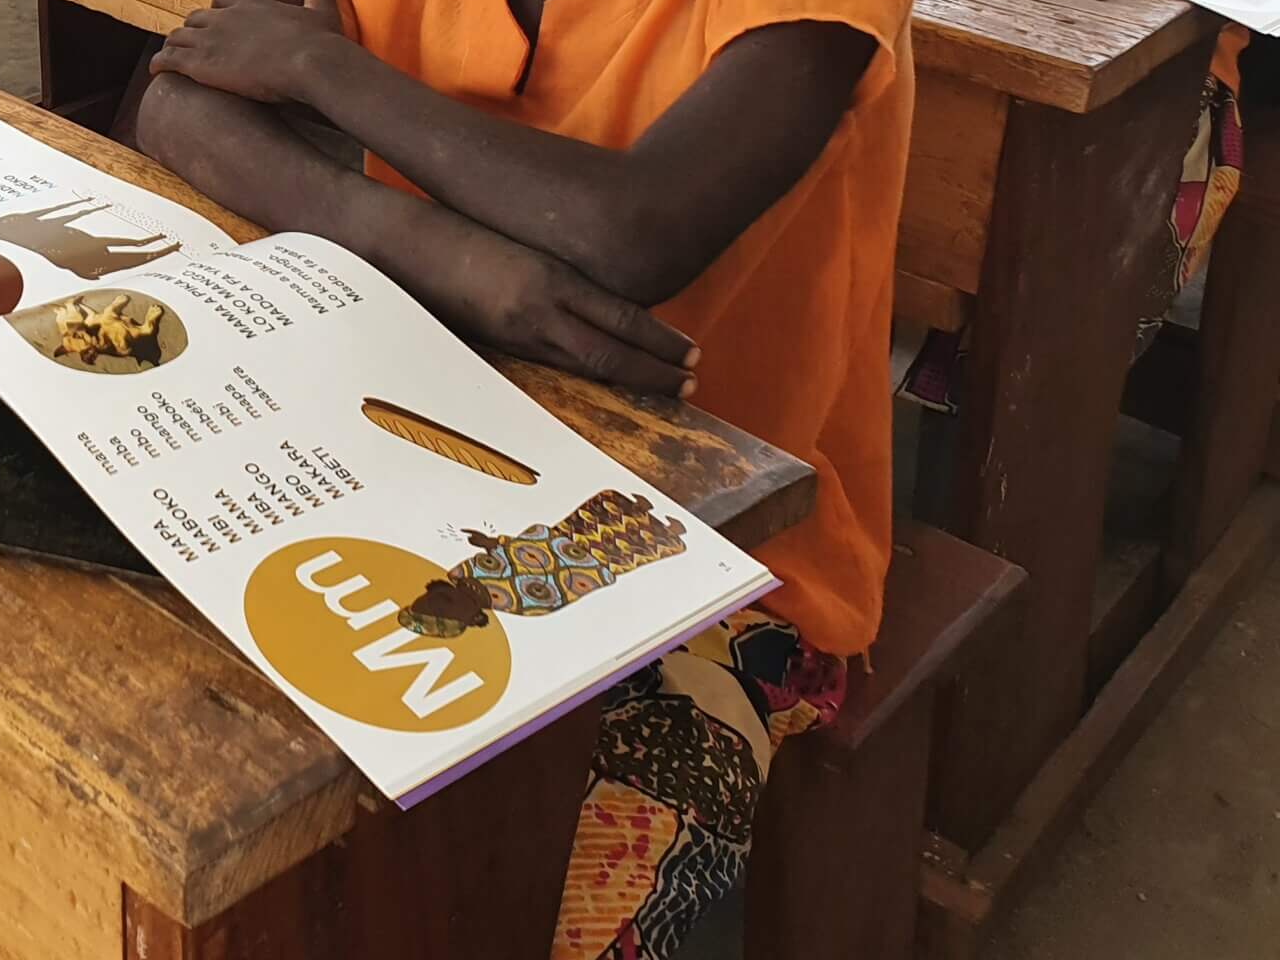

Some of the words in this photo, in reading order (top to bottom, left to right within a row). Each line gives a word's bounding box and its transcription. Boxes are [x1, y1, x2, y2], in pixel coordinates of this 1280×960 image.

[222, 274, 241, 285] FA
[253, 261, 282, 275] pika
[304, 259, 318, 268] fa
[174, 280, 207, 297] PIKA
[290, 283, 329, 314] Mama
[312, 282, 329, 294] ko
[328, 275, 363, 302] Mado
[328, 294, 346, 308] Lo
[214, 304, 257, 339] MAMA
[232, 300, 255, 315] KO
[250, 293, 293, 326] MADO
[253, 316, 276, 333] LO
[225, 384, 262, 419] mapa
[233, 366, 281, 412] makara
[137, 406, 181, 450] mango
[152, 392, 202, 442] maboko
[213, 402, 242, 427] mbi
[78, 432, 117, 475] mama
[109, 436, 139, 467] mba
[131, 429, 160, 458] mbo
[280, 440, 344, 500] MAKARA
[245, 463, 304, 517] MANGO
[285, 475, 325, 508] MBO
[153, 489, 221, 553] MABOKO
[214, 488, 263, 535] MAMA
[247, 492, 284, 525] MBA
[153, 519, 199, 562] MAPA
[208, 515, 242, 544] MBI
[294, 549, 487, 720] Mm
